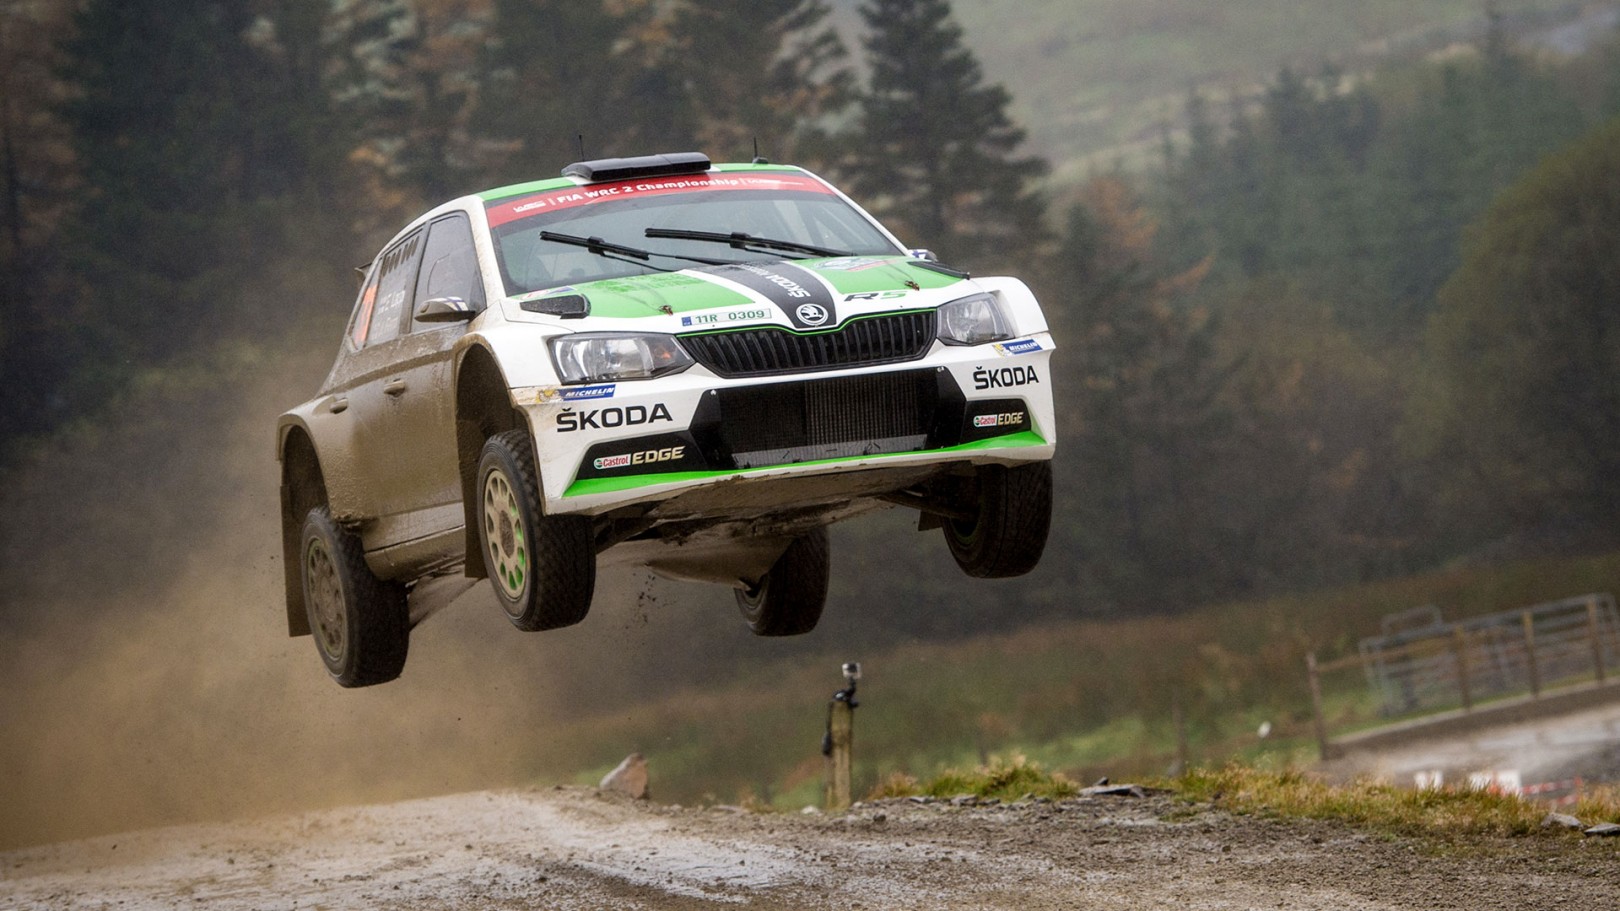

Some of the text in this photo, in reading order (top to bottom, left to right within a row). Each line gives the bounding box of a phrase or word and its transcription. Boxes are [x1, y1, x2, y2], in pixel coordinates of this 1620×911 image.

[556, 194, 583, 204] FIA
[584, 188, 620, 199] WRC
[636, 178, 738, 191] Championship
[844, 290, 908, 302] R5
[695, 314, 718, 324] 11R
[728, 310, 765, 320] 0309
[1009, 342, 1038, 352] MICHELIN
[973, 365, 1039, 390] ŠKODA
[565, 387, 615, 397] MICHELIN
[556, 403, 673, 433] ŠKODA
[997, 412, 1024, 425] EDGE
[602, 445, 686, 467] Castrol EDGE
